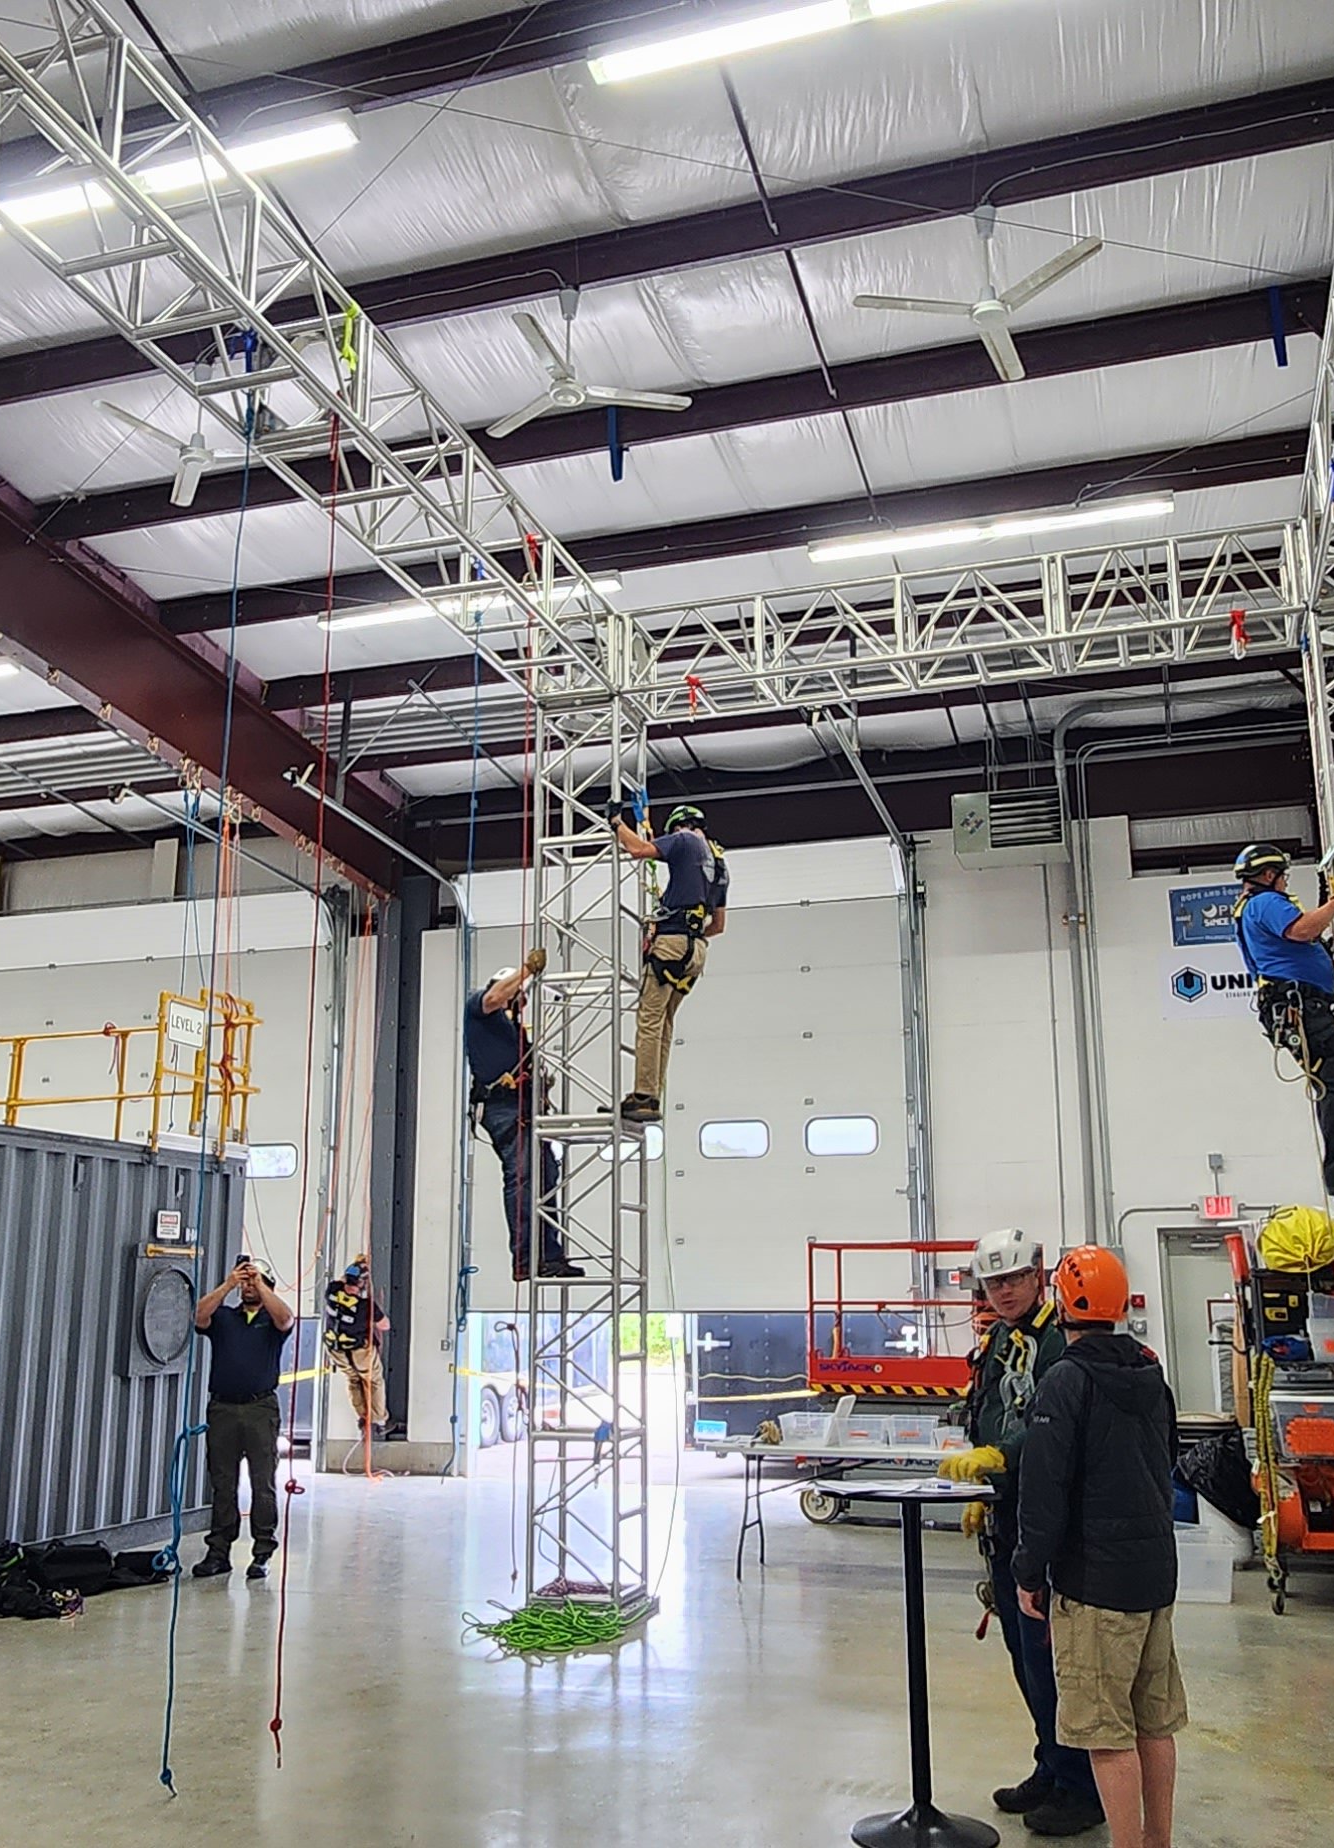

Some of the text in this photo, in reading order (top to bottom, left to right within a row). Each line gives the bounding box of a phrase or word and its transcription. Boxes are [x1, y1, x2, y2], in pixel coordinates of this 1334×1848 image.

[171, 1014, 203, 1035] LEVEL 2
[819, 1360, 874, 1372] SKYJACK
